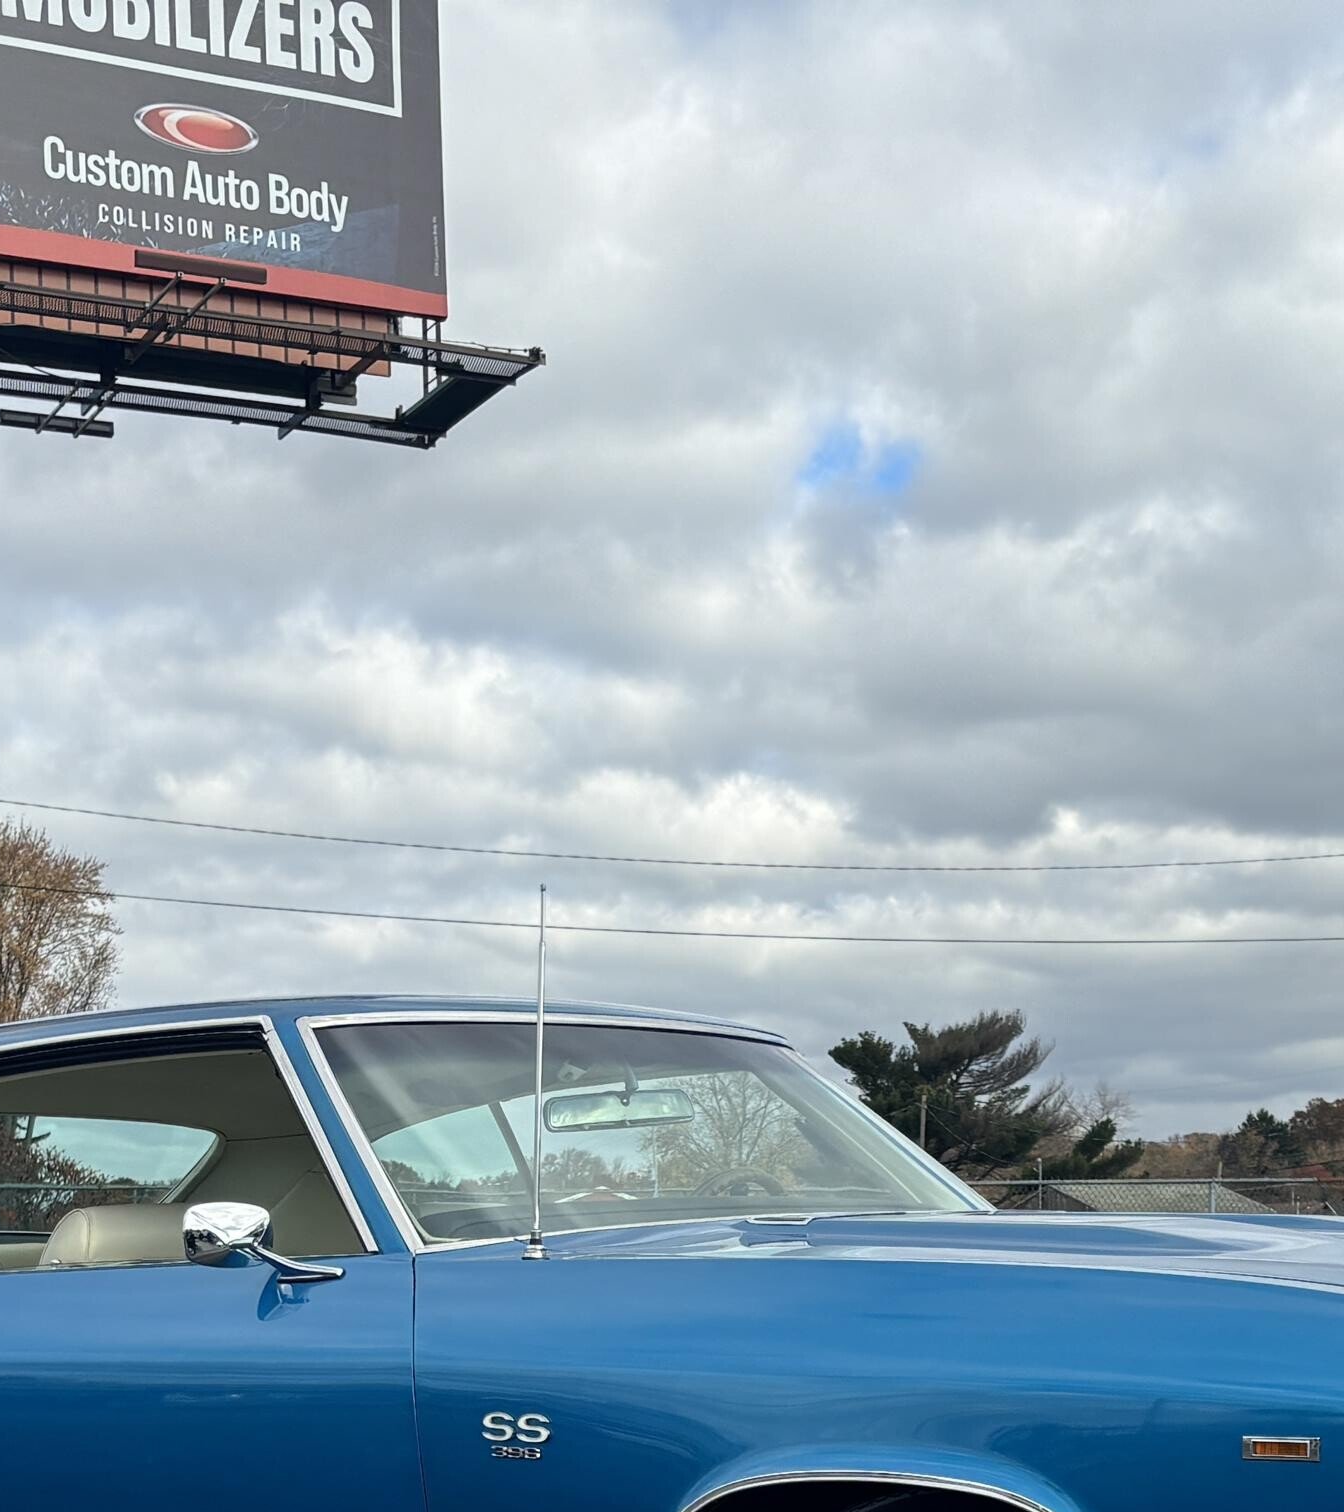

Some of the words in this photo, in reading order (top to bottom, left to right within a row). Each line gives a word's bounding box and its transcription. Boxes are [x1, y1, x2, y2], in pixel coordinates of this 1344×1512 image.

[1, 0, 375, 83] BILIZERS
[43, 135, 175, 199] Custom
[183, 160, 260, 211] Auto
[268, 173, 349, 233] Body
[98, 203, 214, 240] COLLISION
[225, 223, 301, 252] REPAIR
[481, 1411, 551, 1443] SS
